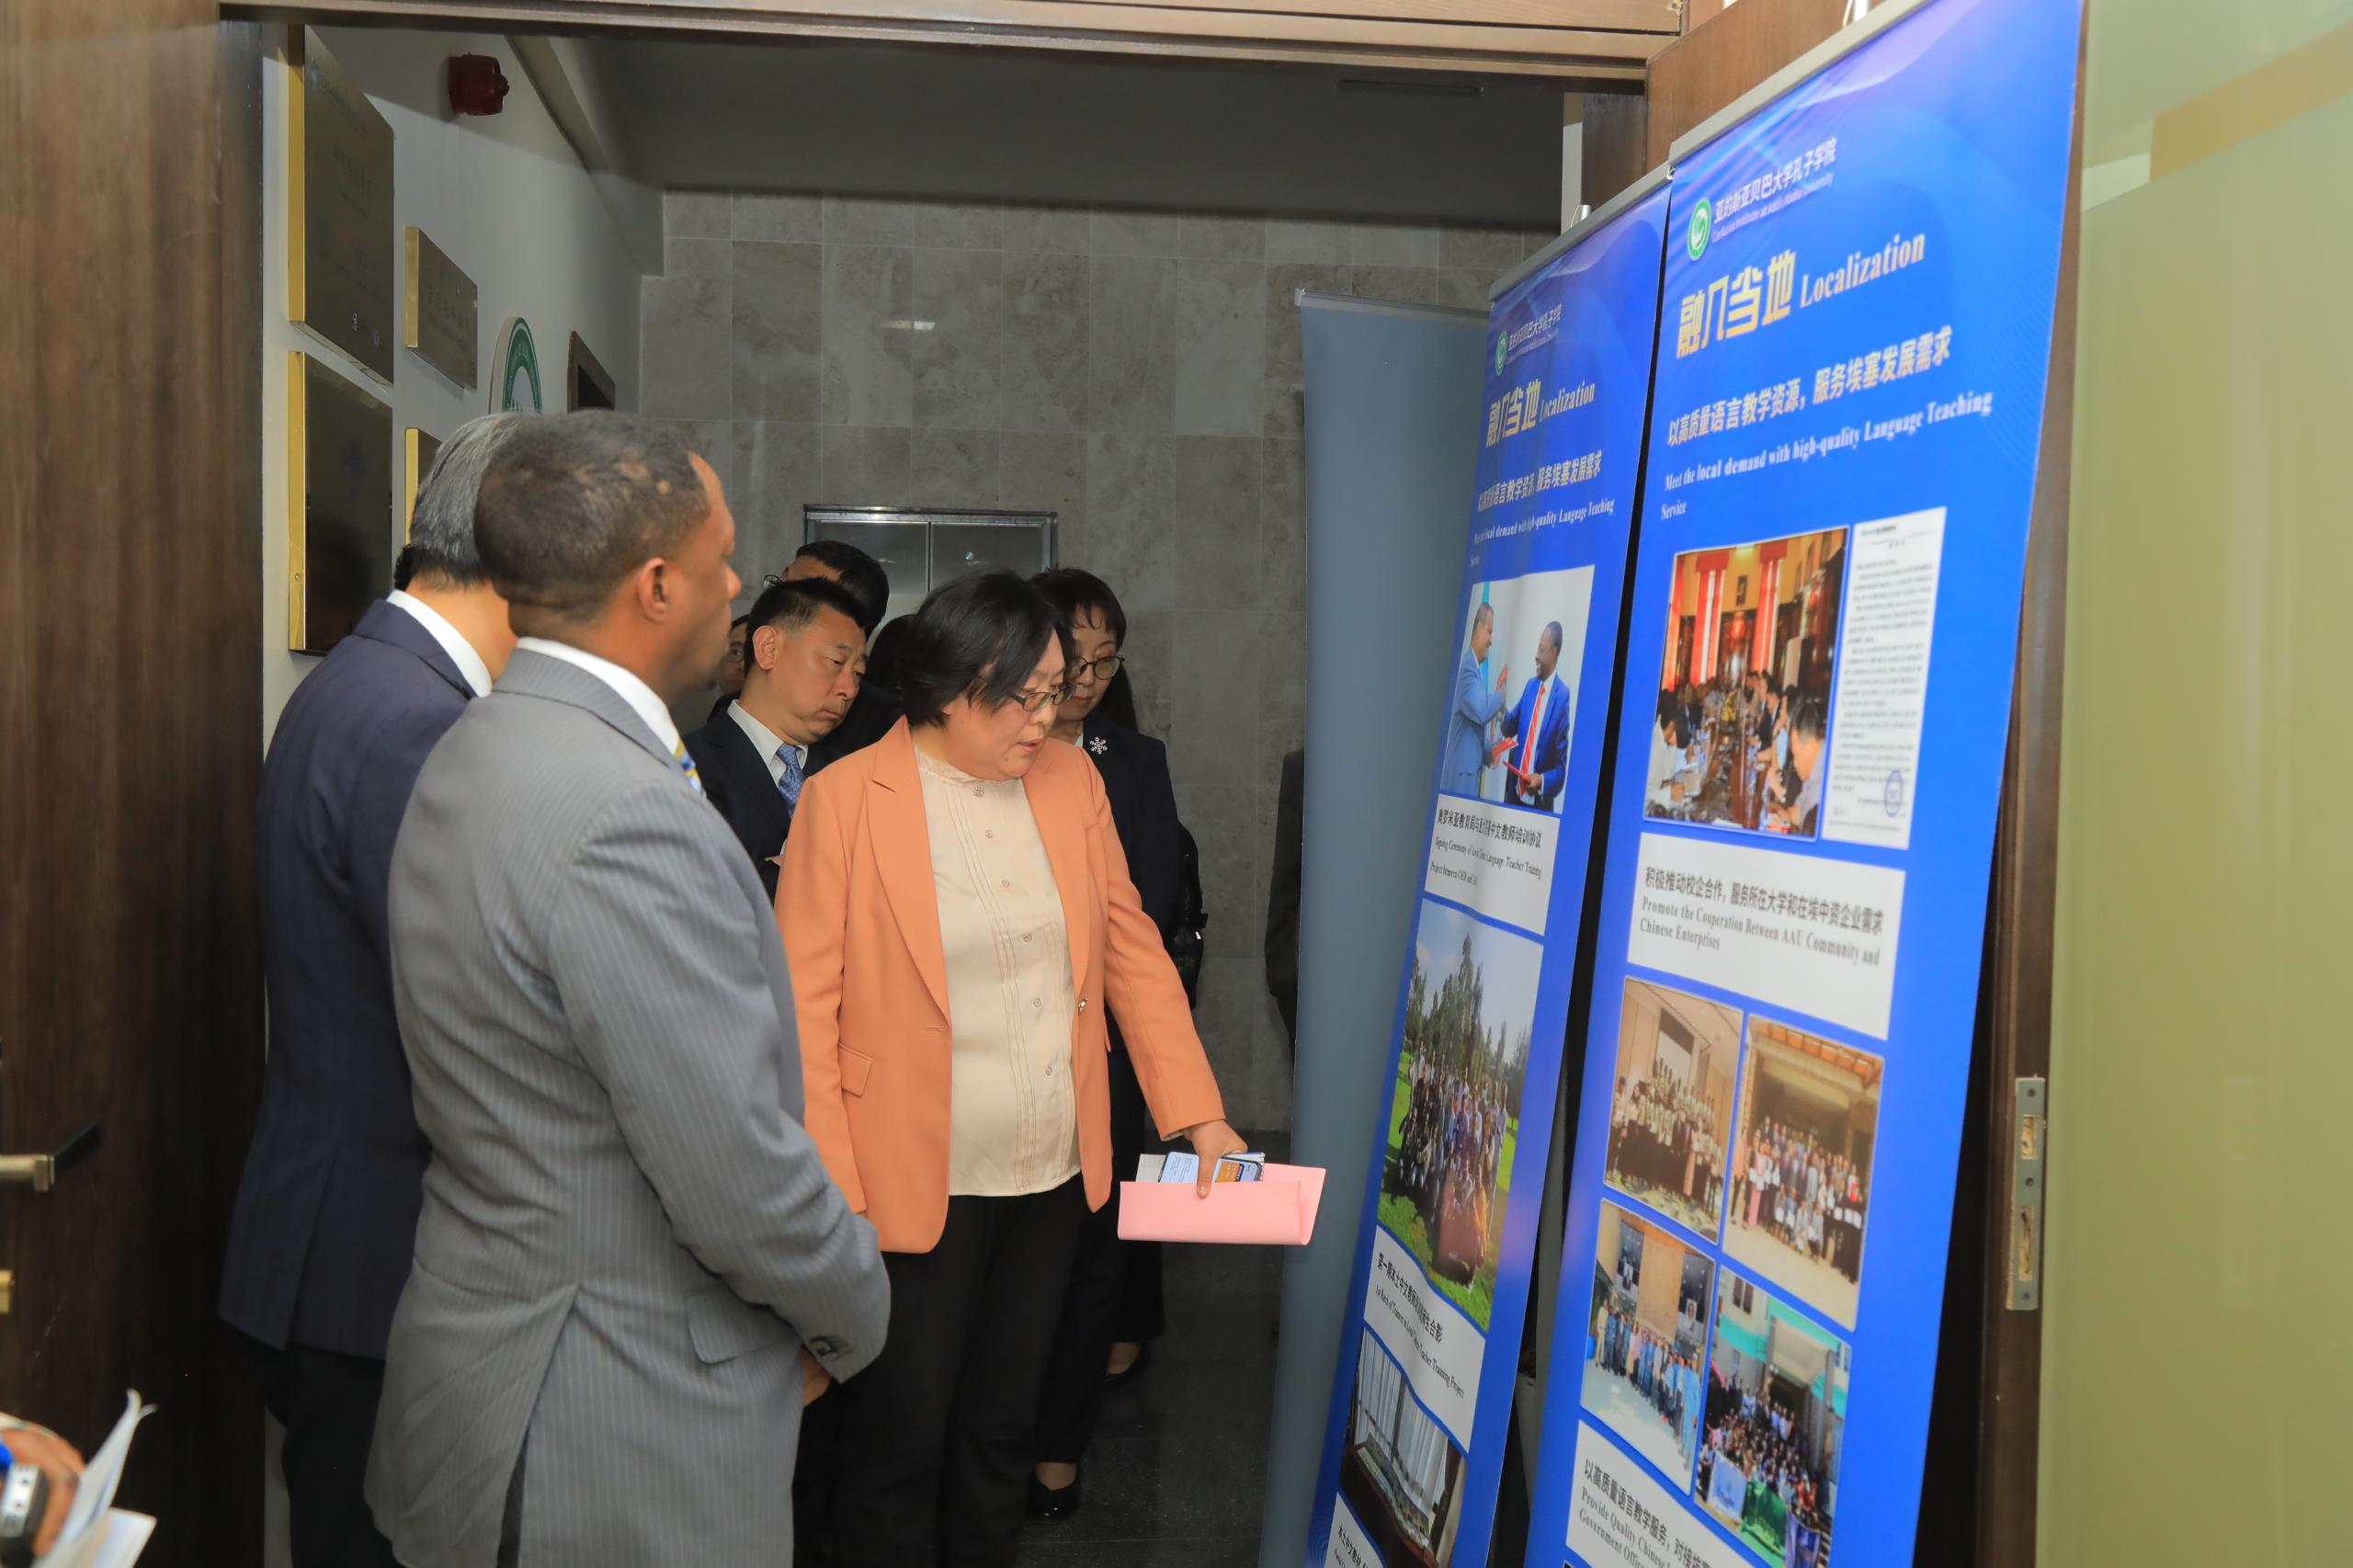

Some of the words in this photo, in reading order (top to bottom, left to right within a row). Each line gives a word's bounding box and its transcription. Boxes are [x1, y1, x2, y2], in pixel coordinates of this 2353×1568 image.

[1800, 233, 1926, 309] Localization
[1665, 473, 1682, 492] Meet
[1683, 467, 1695, 485] the
[1697, 460, 1722, 481] local
[1724, 449, 1767, 476] demand
[1768, 443, 1790, 464] with
[1793, 426, 1859, 461] high-quality
[1864, 412, 1923, 441] Language
[1927, 391, 1993, 417] Teaching
[1661, 499, 1687, 520] Service
[1640, 918, 1673, 938] Chinese
[1676, 925, 1720, 950] Enterprises
[1642, 896, 1678, 917] Promote
[1681, 904, 1693, 920] the
[1696, 908, 1744, 931] Cooperation
[1745, 918, 1779, 941] Between
[1782, 927, 1804, 947] AAU
[1806, 932, 1859, 965] Community
[1862, 948, 1881, 966] and
[1579, 1508, 1622, 1553] Government
[1582, 1486, 1608, 1521] Provide
[1610, 1513, 1636, 1547] Quality
[1638, 1536, 1664, 1567] Chinese
